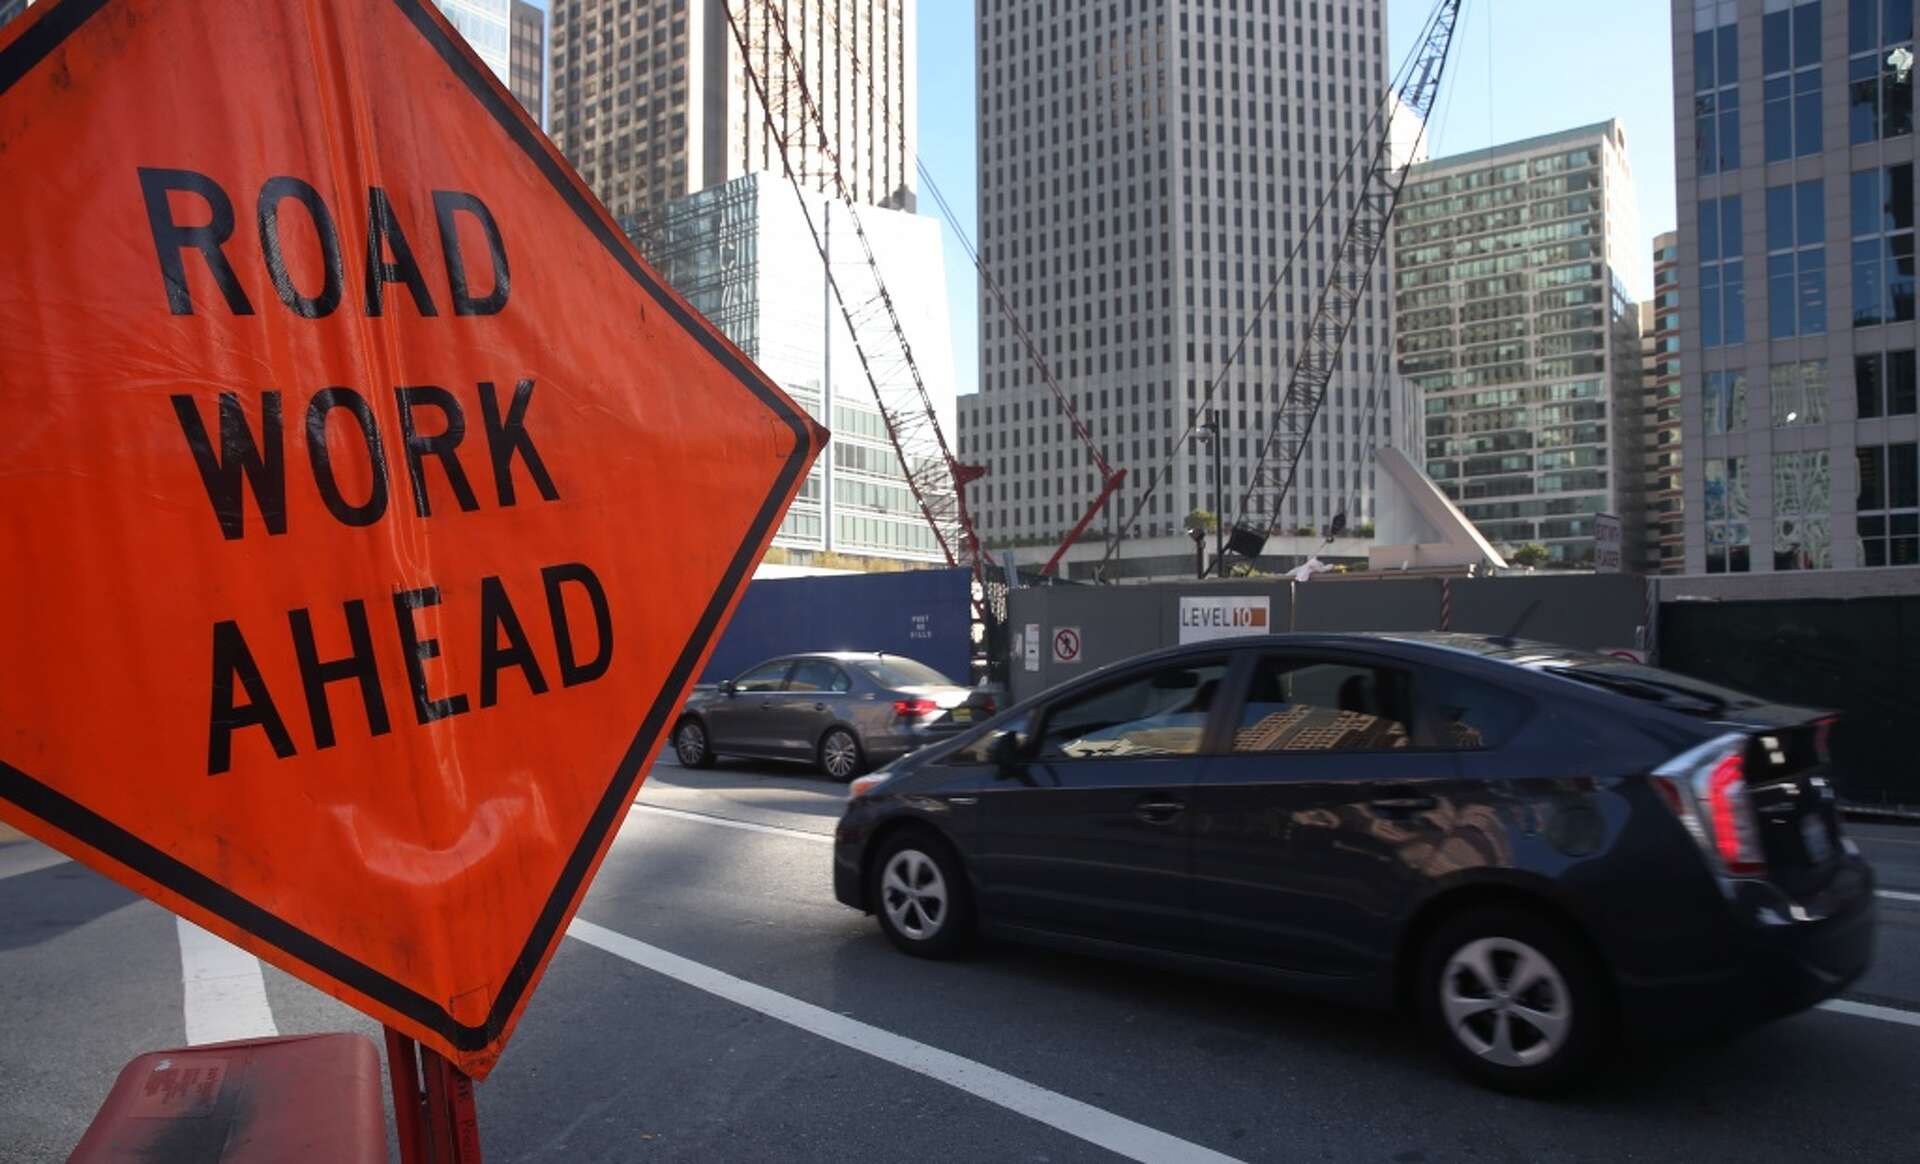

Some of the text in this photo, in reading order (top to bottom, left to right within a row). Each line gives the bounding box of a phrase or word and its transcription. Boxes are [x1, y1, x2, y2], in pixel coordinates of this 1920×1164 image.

[137, 167, 511, 319] ROAD
[170, 379, 561, 541] WORK
[207, 562, 614, 777] AHEAD
